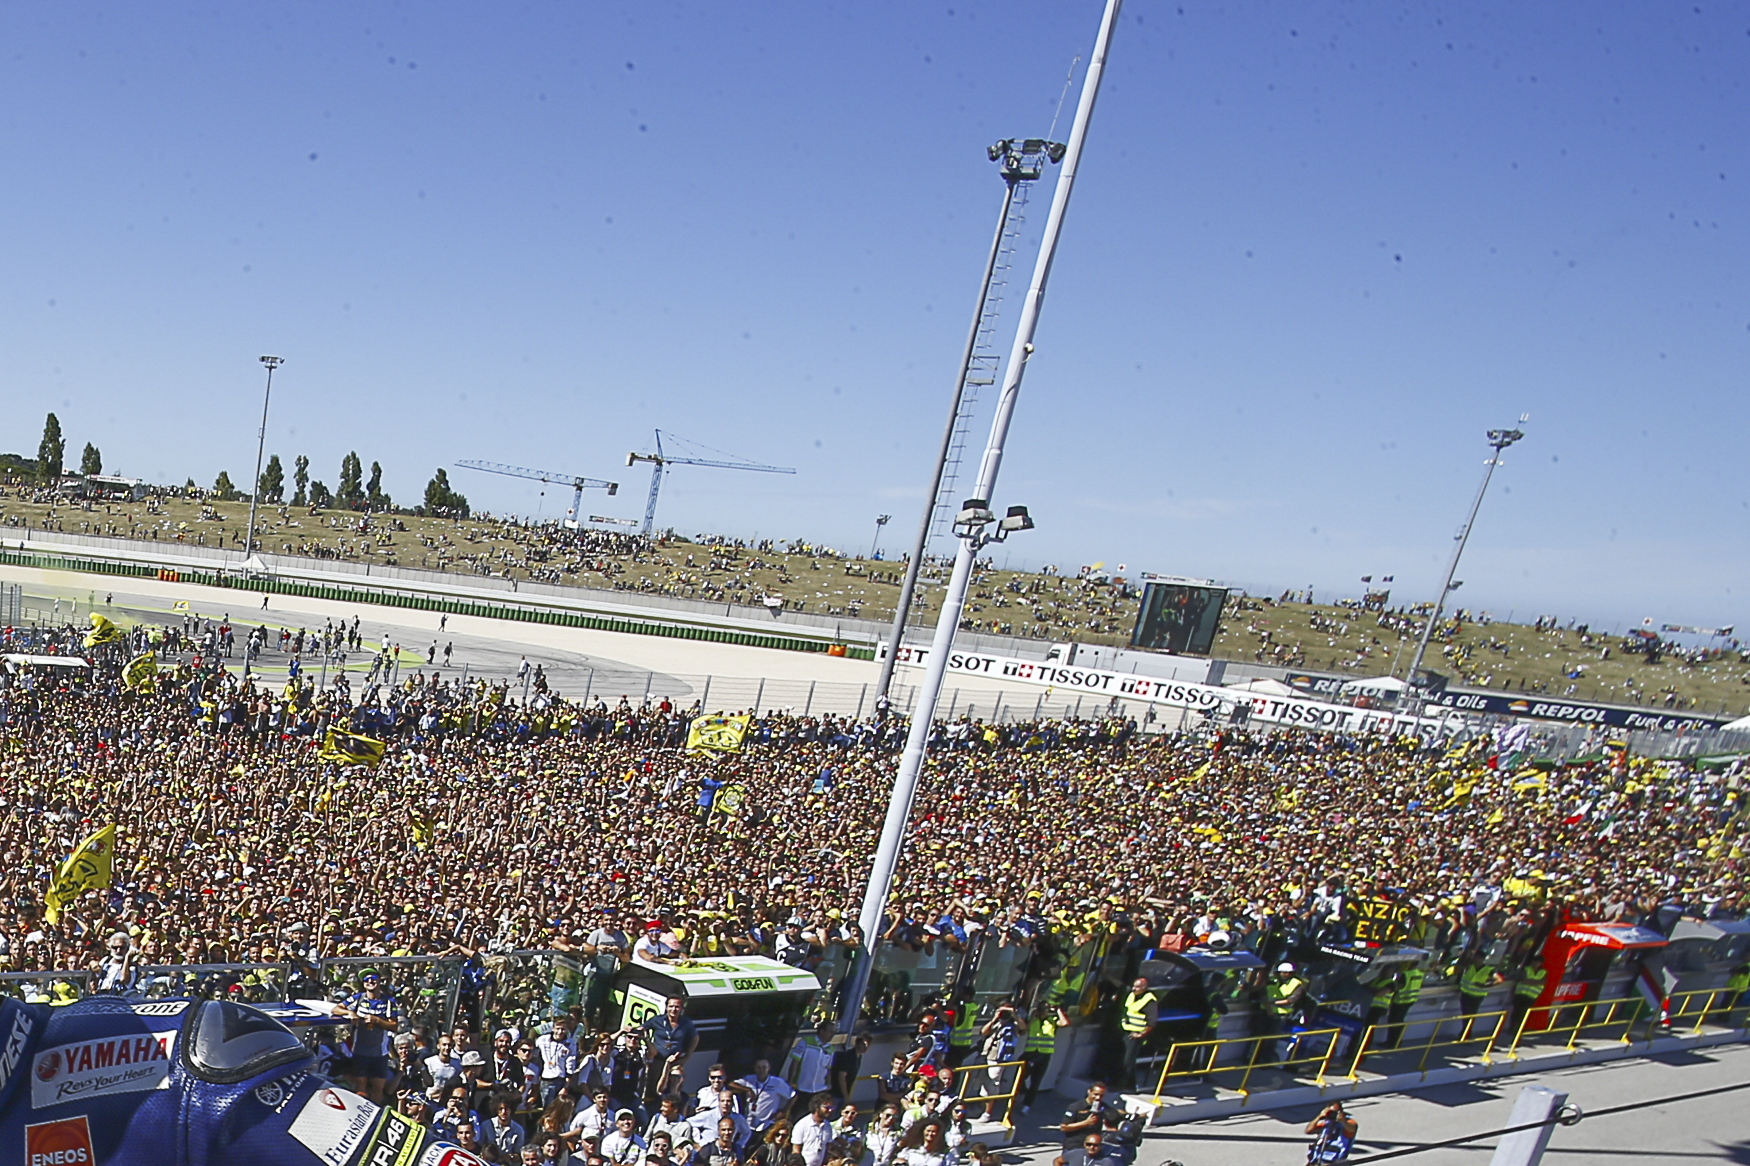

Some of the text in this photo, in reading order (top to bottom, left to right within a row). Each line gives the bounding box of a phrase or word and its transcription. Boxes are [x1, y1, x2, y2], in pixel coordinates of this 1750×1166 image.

[1036, 666, 1115, 690] TISSOT
[1154, 682, 1225, 707] TISSO
[1270, 701, 1354, 728] TISSOT
[1456, 694, 1489, 709] Oils
[1531, 703, 1607, 723] REPSOL
[1625, 713, 1661, 729] Fuel
[733, 977, 773, 991] GO&FUN
[64, 1036, 169, 1075] YAMAHA
[325, 1113, 366, 1166] Eurasian
